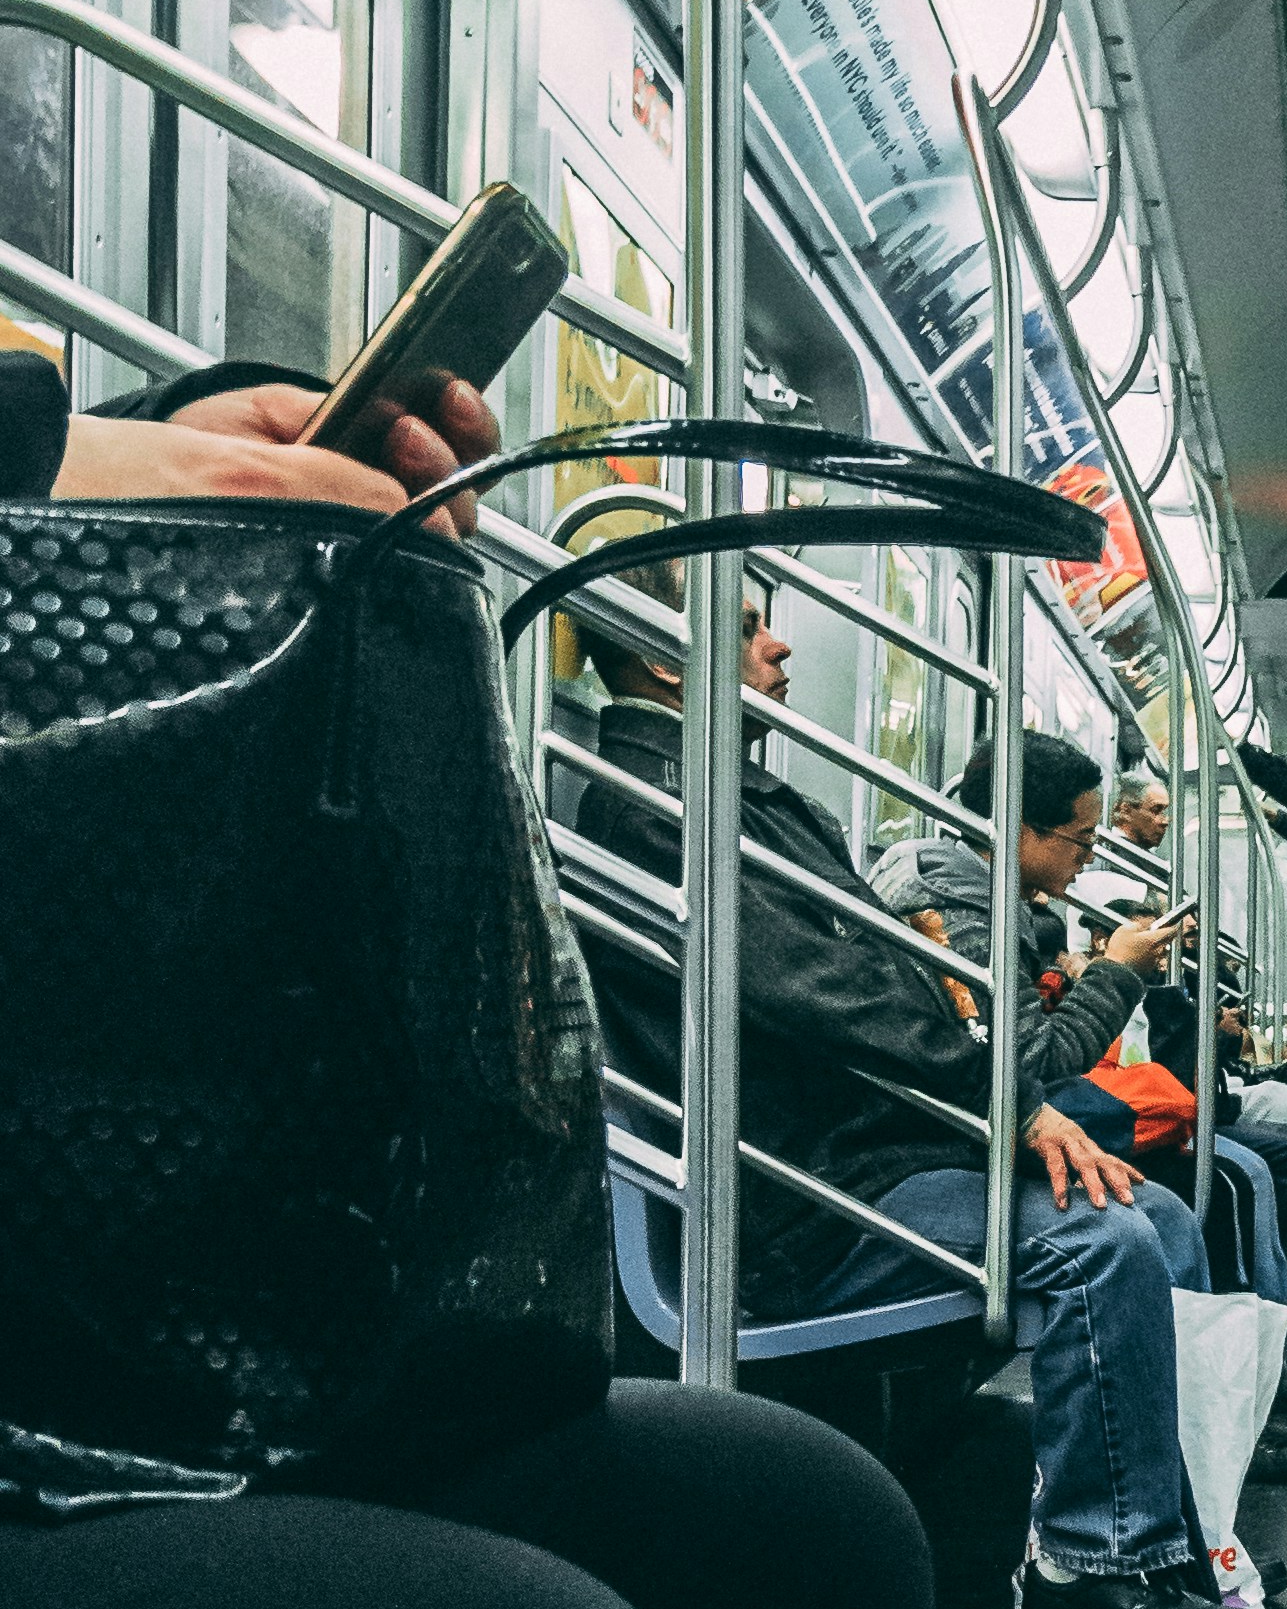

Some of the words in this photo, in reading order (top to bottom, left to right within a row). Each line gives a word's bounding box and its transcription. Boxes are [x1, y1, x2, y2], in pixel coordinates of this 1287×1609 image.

[866, 23, 895, 62] made
[831, 48, 849, 66] in
[881, 57, 899, 84] my
[840, 56, 869, 94] NYC
[890, 72, 912, 100] life
[853, 89, 887, 131] should
[898, 95, 914, 113] so
[904, 109, 932, 143] much
[1207, 1546, 1237, 1572] re
